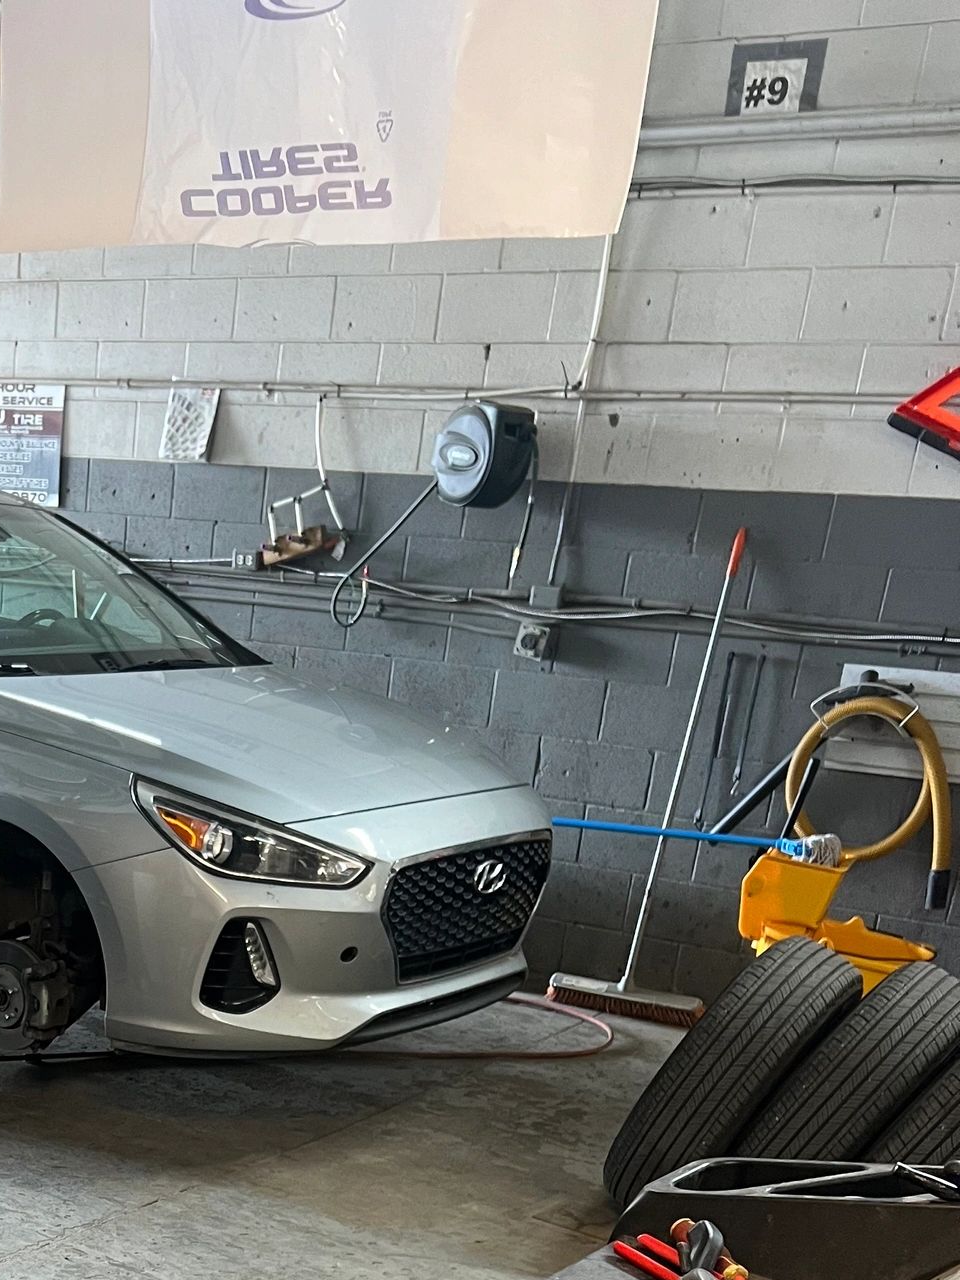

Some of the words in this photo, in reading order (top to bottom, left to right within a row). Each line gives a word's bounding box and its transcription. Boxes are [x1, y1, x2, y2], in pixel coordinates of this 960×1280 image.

[744, 76, 789, 109] #9
[2, 396, 54, 406] SERVICE
[12, 414, 44, 426] TIRE
